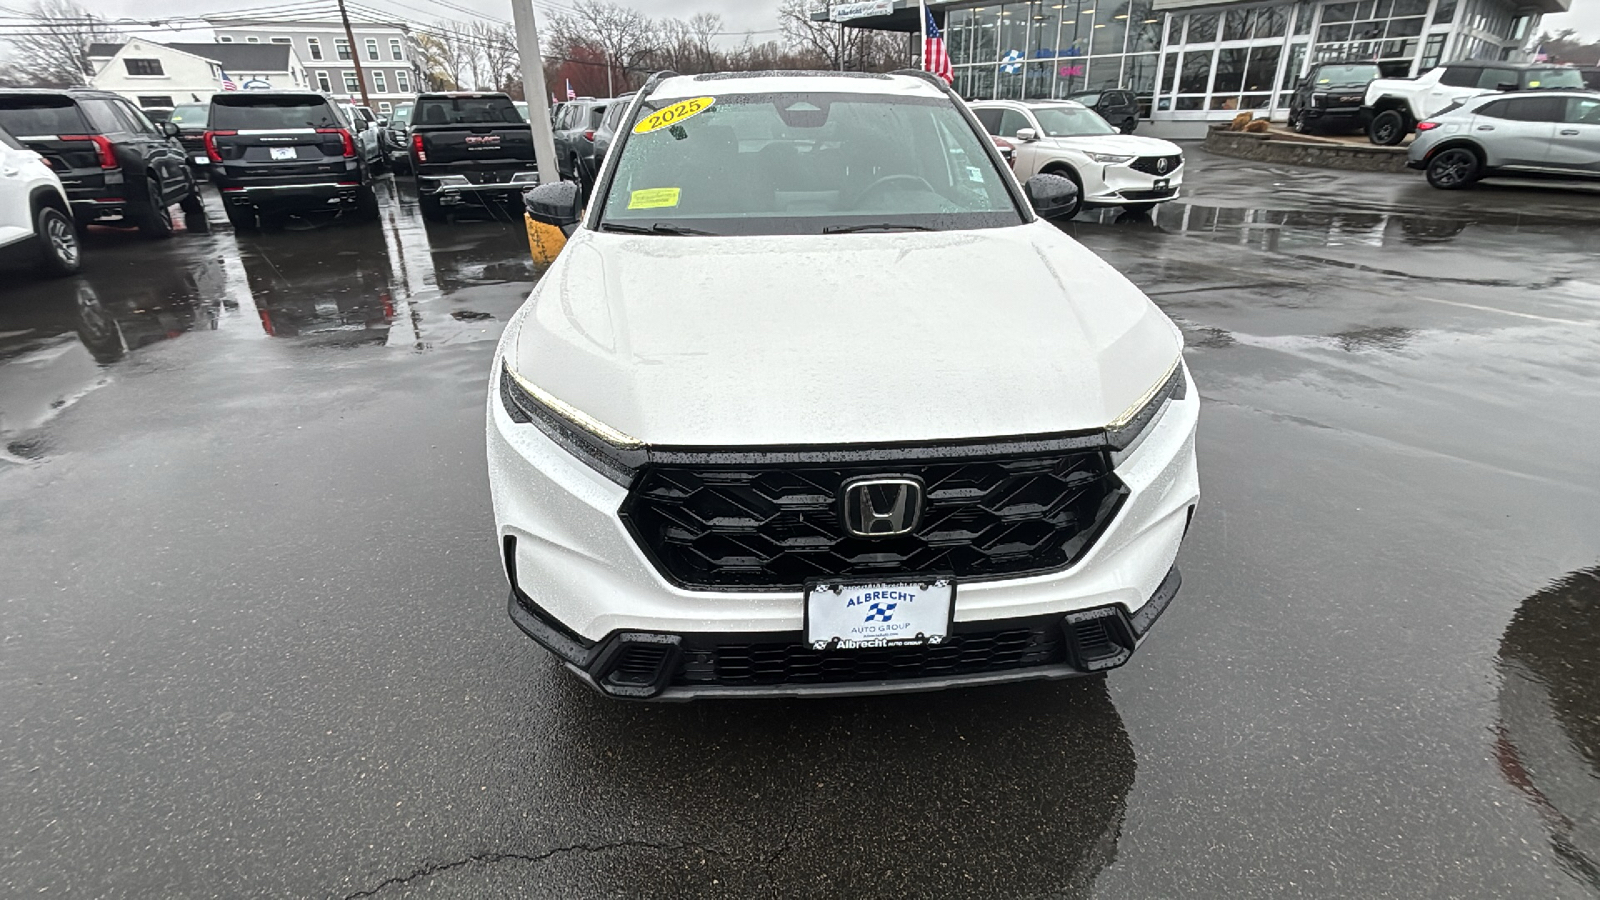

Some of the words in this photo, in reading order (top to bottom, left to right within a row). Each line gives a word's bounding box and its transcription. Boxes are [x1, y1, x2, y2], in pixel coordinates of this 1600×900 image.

[1059, 66, 1084, 76] GMC
[649, 99, 701, 129] 2025
[465, 136, 501, 144] GMC
[847, 591, 915, 607] ALBRECHT
[878, 623, 910, 631] GROUP
[837, 638, 887, 648] Albrecht
